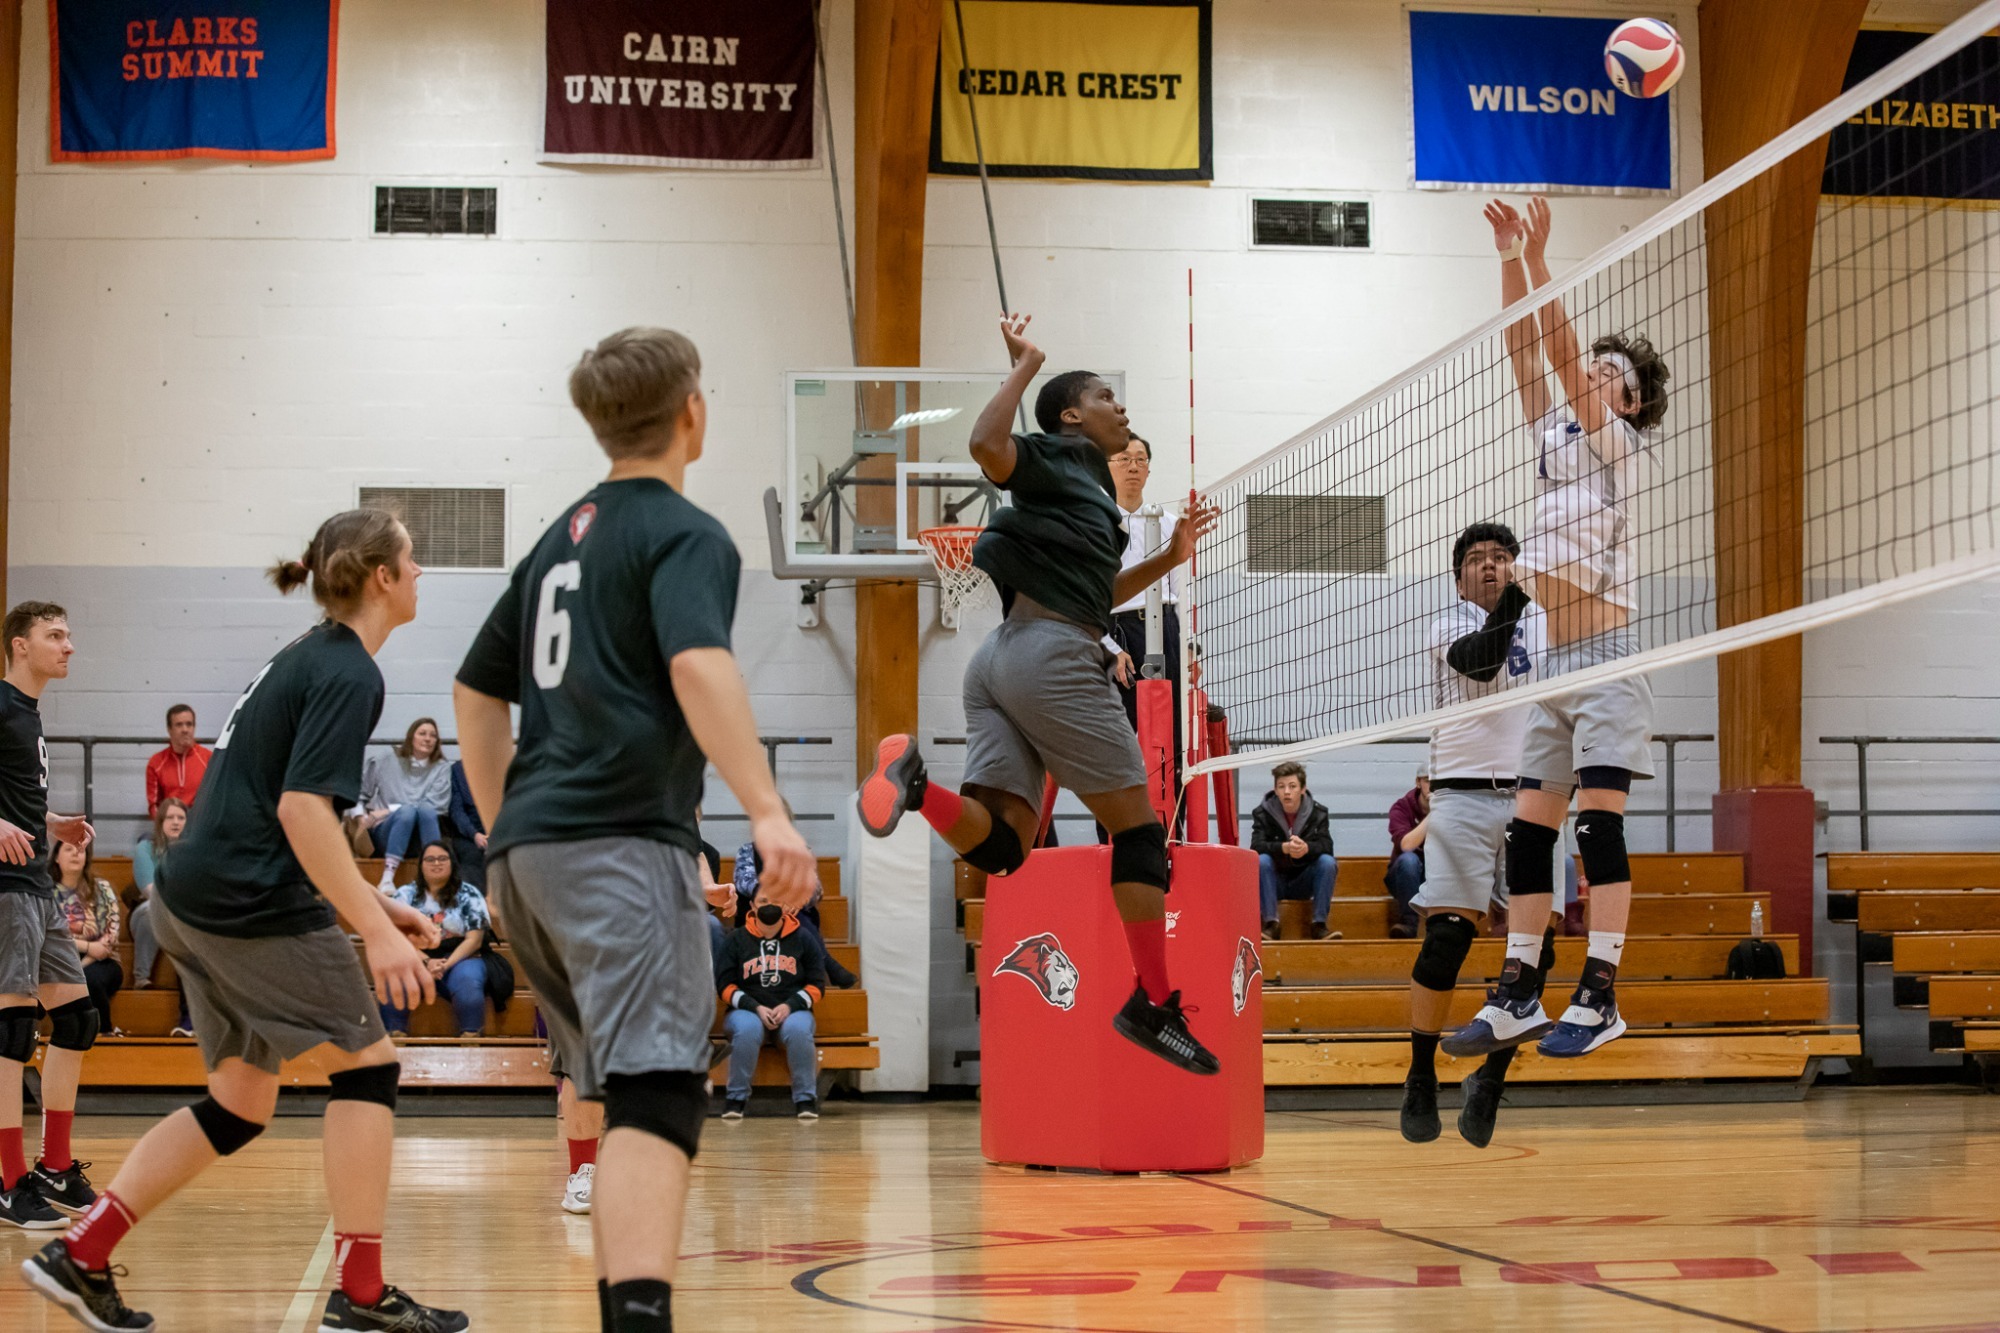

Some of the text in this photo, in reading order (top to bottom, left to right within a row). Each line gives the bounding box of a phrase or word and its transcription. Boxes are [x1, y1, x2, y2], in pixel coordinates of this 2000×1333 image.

[126, 17, 258, 48] CLARKS
[623, 32, 740, 66] CAIRN
[121, 50, 264, 81] SUMMIT
[564, 74, 798, 112] UNIVERSITY
[958, 68, 1182, 100] CEDAR CREST
[1468, 84, 1616, 116] WILSON
[532, 559, 582, 690] 6
[868, 1248, 2000, 1300] IONS
